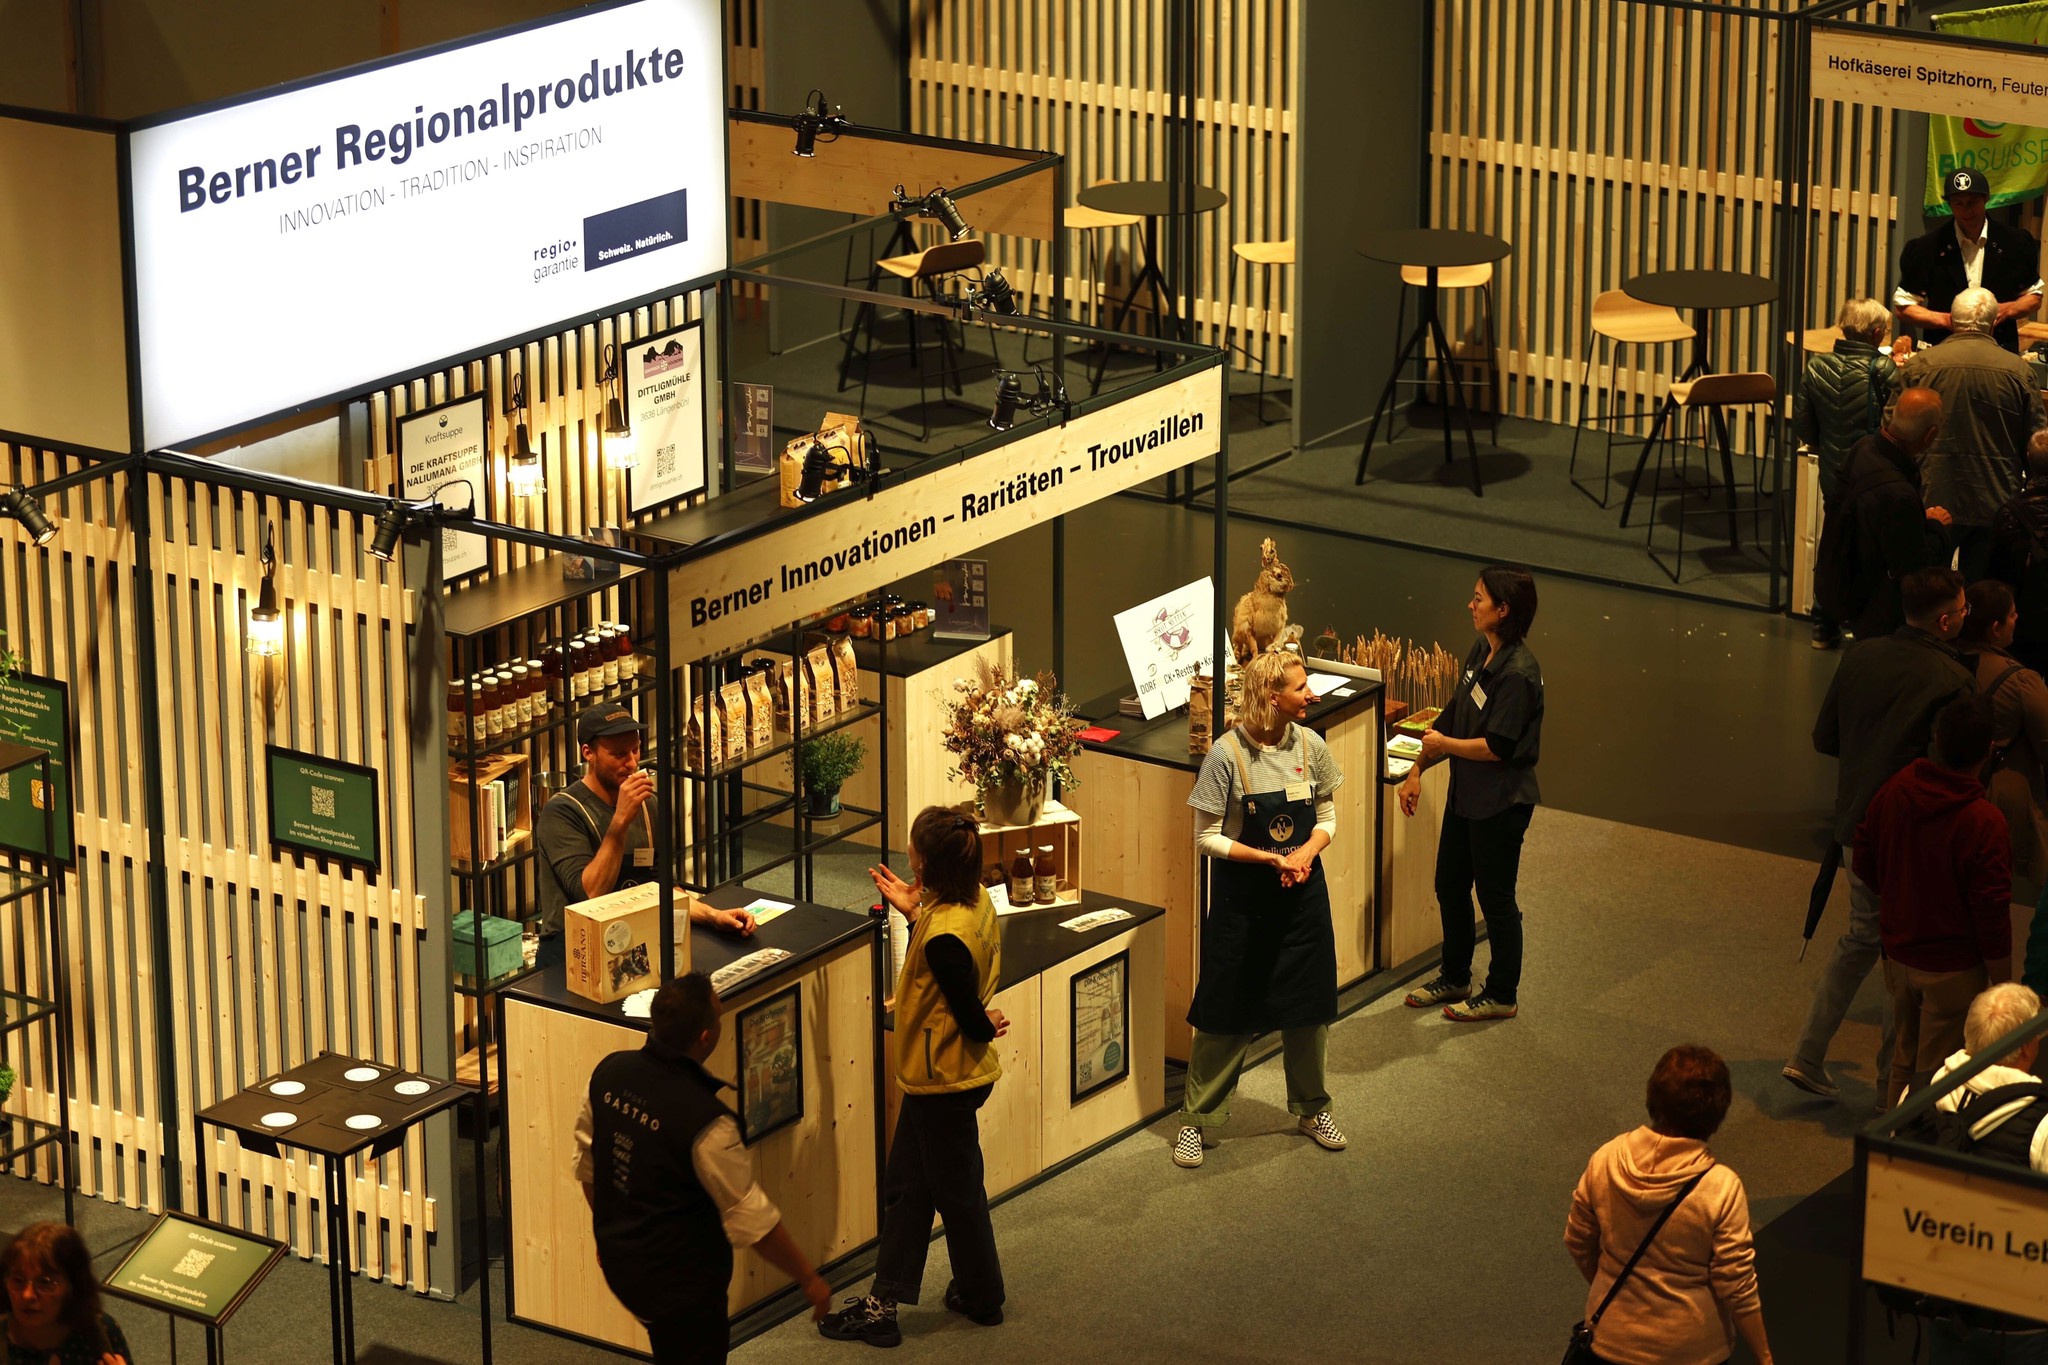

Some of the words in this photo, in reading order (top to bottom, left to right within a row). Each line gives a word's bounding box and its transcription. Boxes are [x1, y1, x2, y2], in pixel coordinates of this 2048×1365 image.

[1828, 55, 1911, 79] Hofkäserei
[1916, 66, 1997, 92] Spitzhorn,
[178, 145, 321, 213] Berner
[336, 46, 684, 170] Regionalprodukte
[279, 186, 385, 234] INNOVATION
[400, 156, 488, 199] TRADITION
[503, 125, 602, 170] INSPIRATION
[598, 242, 634, 261] Schweiz.
[635, 231, 673, 250] Natürlich.
[533, 255, 579, 284] garantie
[637, 372, 691, 398] DITTLIGMÜHLE
[653, 390, 676, 405] GMBH
[640, 407, 656, 422] 3636
[656, 397, 690, 416] Längenbühl
[424, 425, 464, 445] Kraftsuppe
[406, 465, 457, 488] NALIUMANA
[459, 455, 482, 472] GMBH
[410, 462, 425, 474] DIE
[426, 444, 479, 470] KRAFTSUPPE
[690, 575, 774, 628] Berner
[781, 515, 936, 593] Innovationen
[961, 466, 1063, 523] Raritäten
[1087, 412, 1204, 472] Trouvaillen
[1, 694, 51, 711] Regionalprodukte
[30, 691, 46, 700] voller
[19, 707, 39, 719] Hause:
[299, 767, 323, 778] QR-Code
[323, 773, 345, 783] scannen
[293, 820, 310, 830] Berner
[310, 824, 356, 841] Regionalprodukte
[296, 830, 320, 841] virtuellen
[320, 835, 334, 846] Shop
[333, 838, 361, 851] entdecken
[604, 1091, 660, 1131] GASTRO
[1903, 1207, 1994, 1251] Verein
